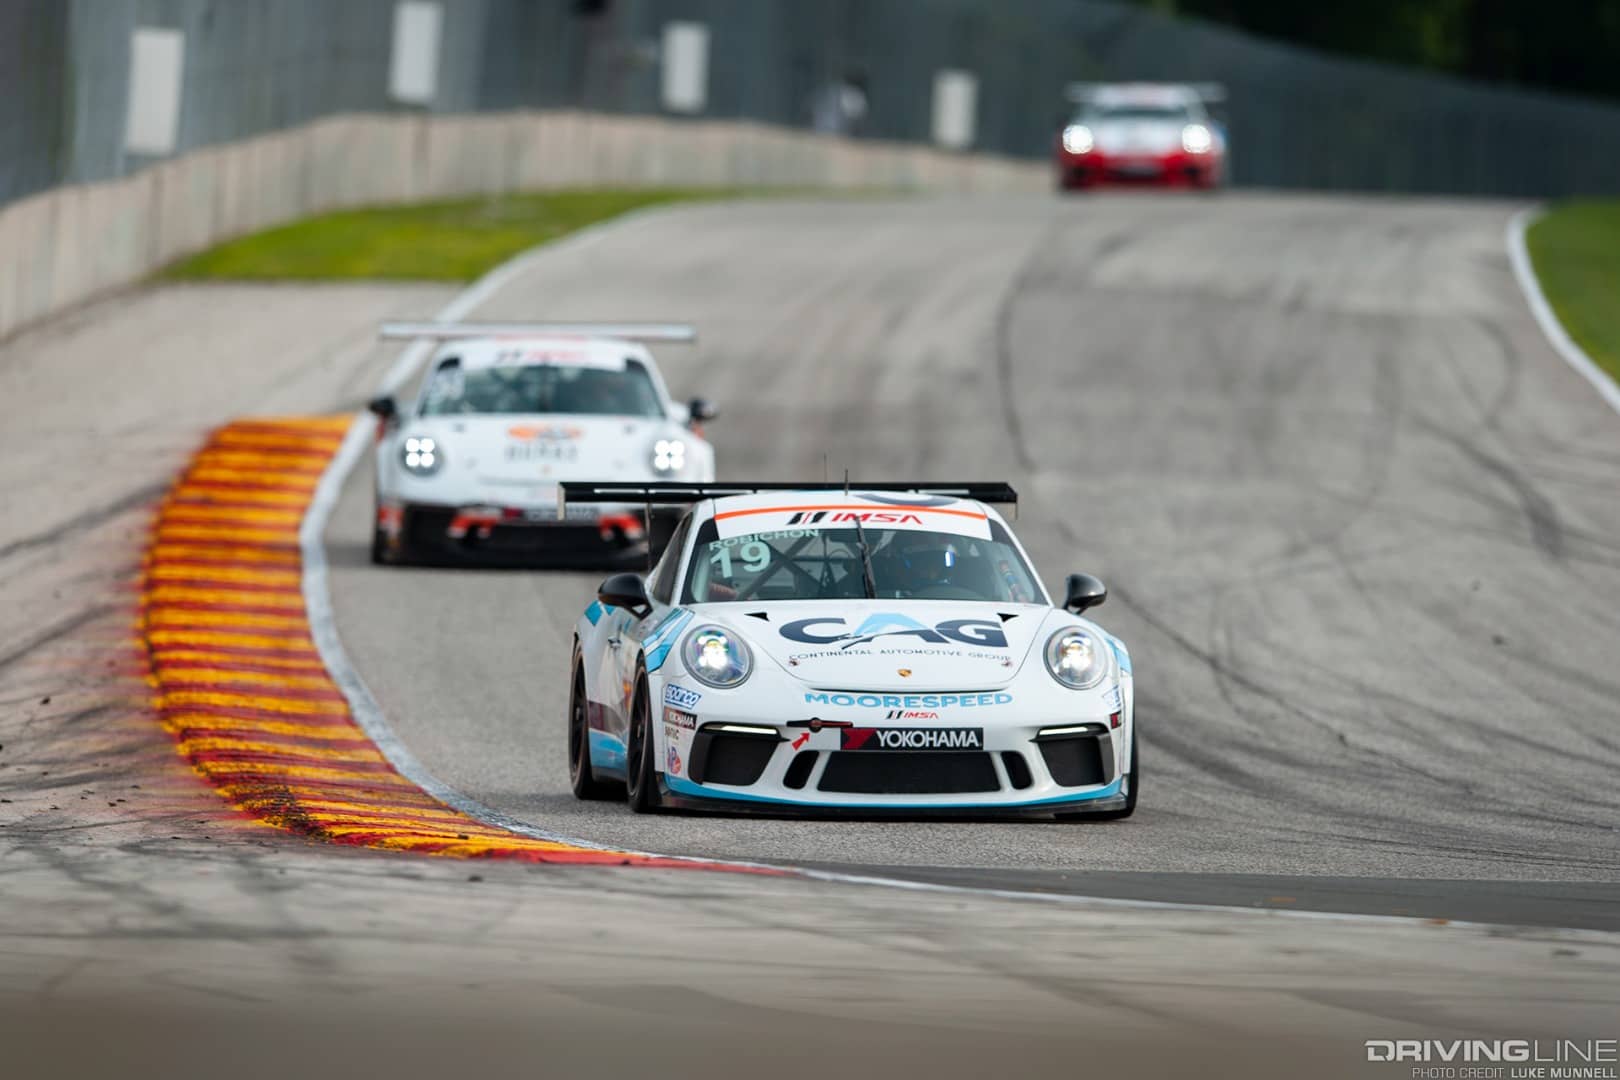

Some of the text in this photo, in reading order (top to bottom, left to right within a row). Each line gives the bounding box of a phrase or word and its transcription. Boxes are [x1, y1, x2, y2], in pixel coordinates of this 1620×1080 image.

[831, 512, 923, 525] IMSA
[708, 528, 820, 551] ROBICHON
[710, 541, 772, 578] 19
[778, 612, 1009, 650] CAG
[788, 649, 1012, 661] CONTINENTAL AUTOMOTIVE GROUP
[804, 693, 1014, 709] MOORESPEED
[902, 710, 939, 720] IMSA
[876, 730, 979, 748] YOKOHAMA
